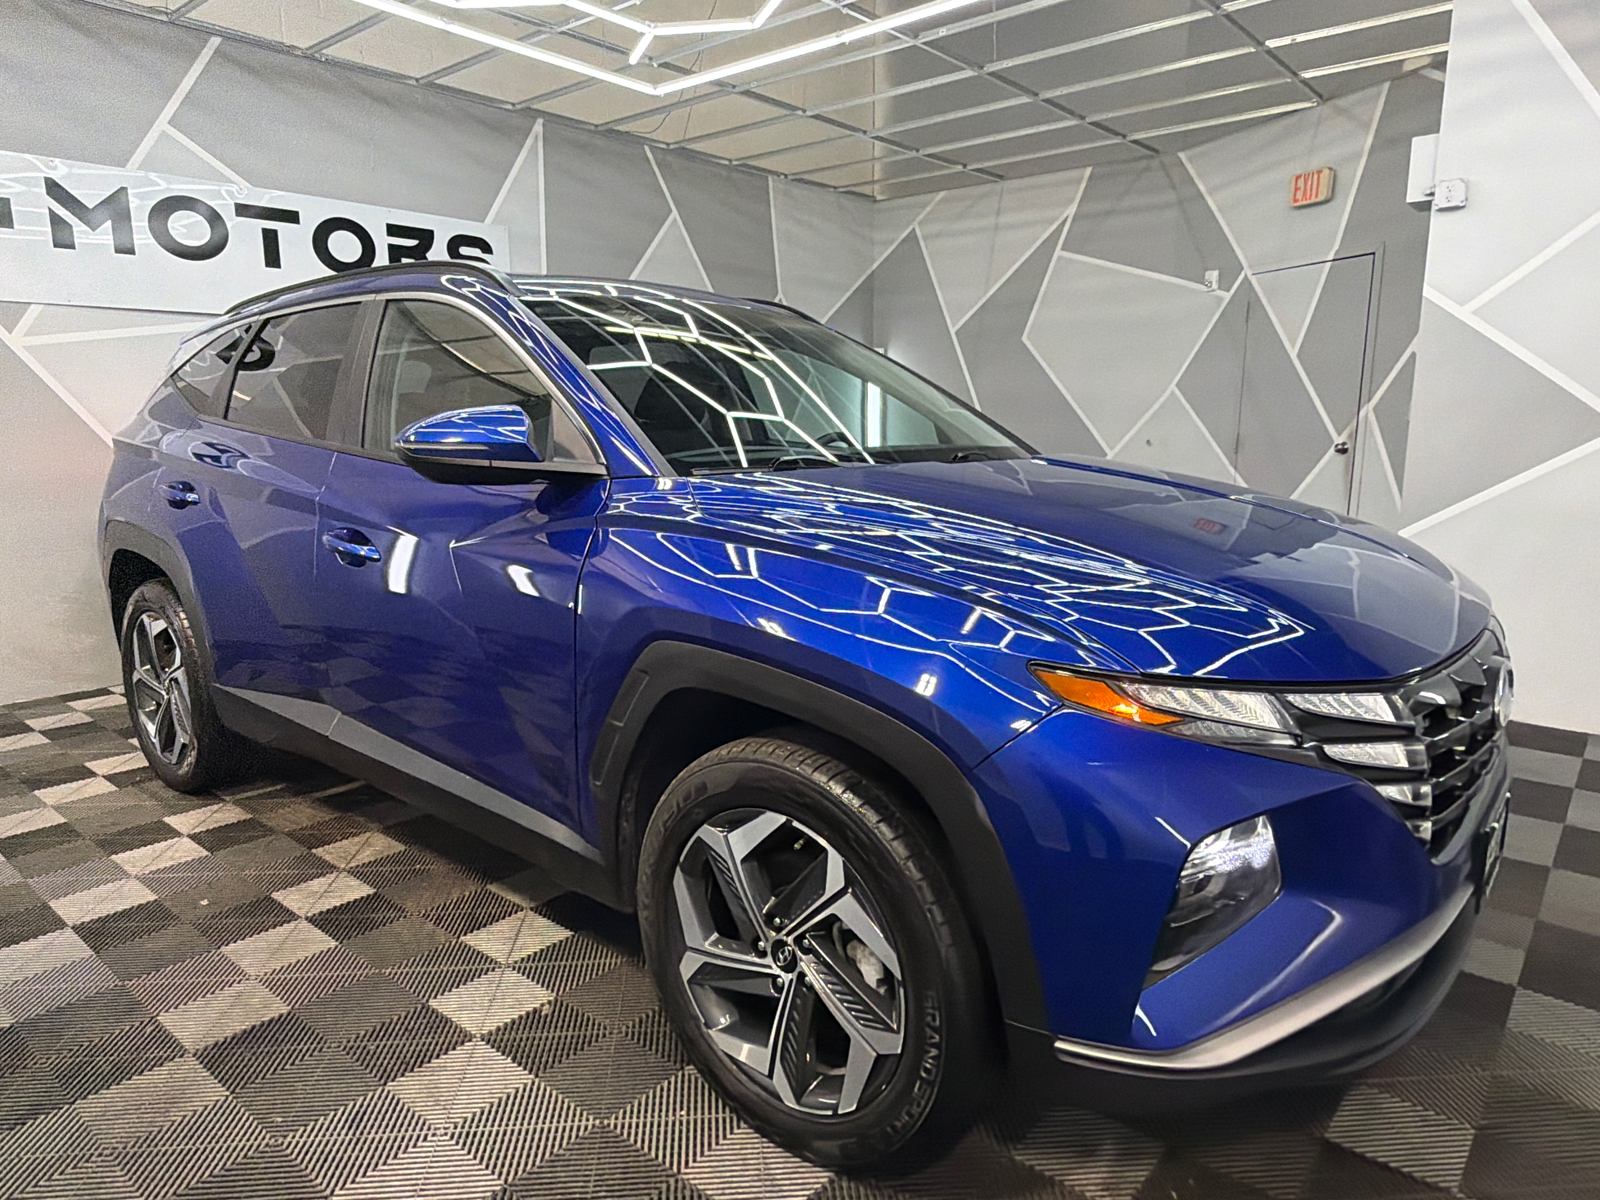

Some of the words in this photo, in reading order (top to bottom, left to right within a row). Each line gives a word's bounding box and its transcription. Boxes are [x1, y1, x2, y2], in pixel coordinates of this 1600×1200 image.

[1293, 170, 1323, 204] EXIT
[44, 176, 494, 272] MOTORS
[921, 991, 940, 1081] GRAND
[887, 1080, 932, 1136] SPORT
